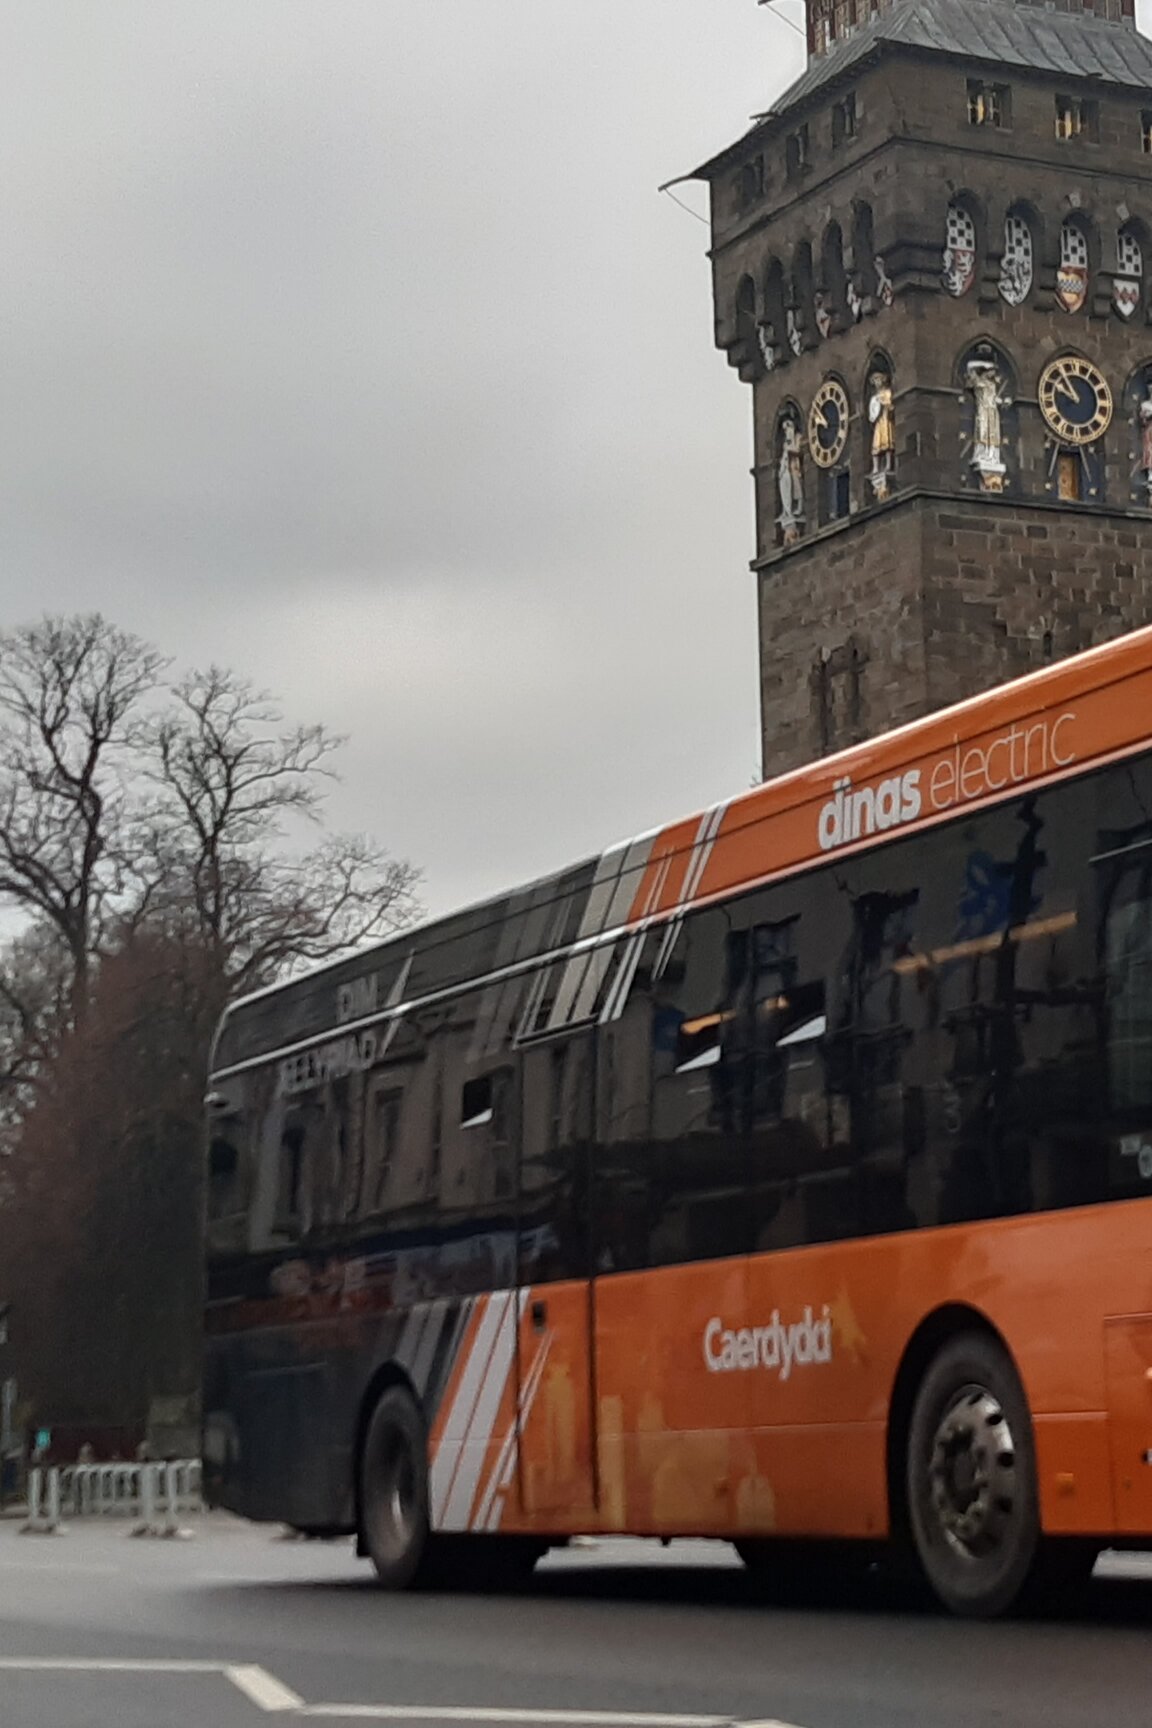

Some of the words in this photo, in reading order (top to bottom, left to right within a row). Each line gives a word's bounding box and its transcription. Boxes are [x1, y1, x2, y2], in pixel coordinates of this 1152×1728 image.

[818, 769, 921, 850] dinas
[930, 713, 1076, 810] electric
[704, 1304, 832, 1381] Caerdydd
